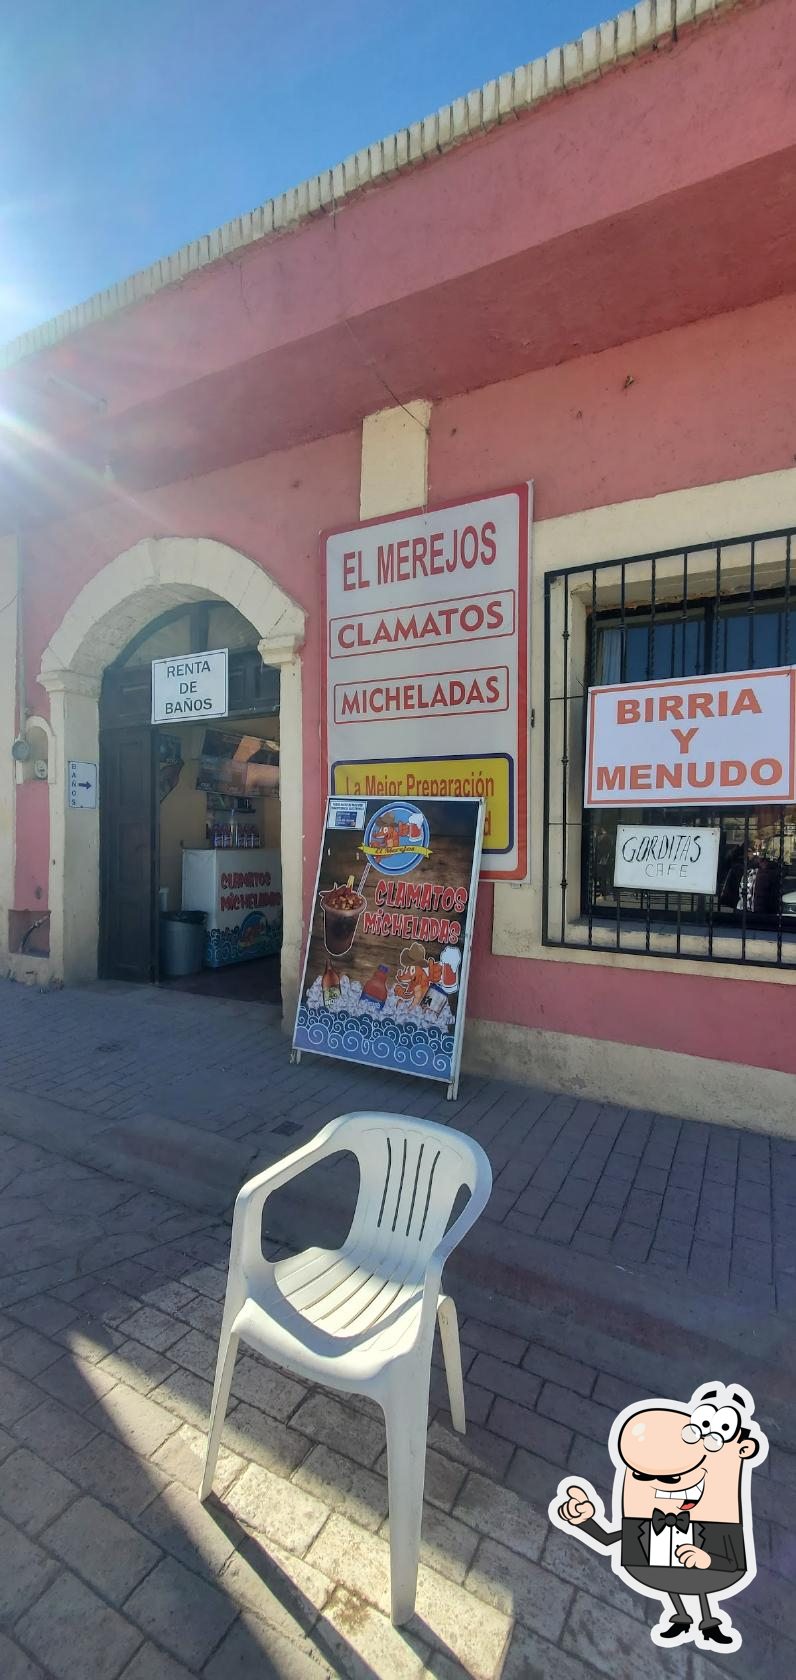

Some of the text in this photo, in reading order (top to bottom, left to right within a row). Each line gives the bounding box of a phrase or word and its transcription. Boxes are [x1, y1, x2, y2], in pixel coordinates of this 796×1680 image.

[343, 521, 497, 592] EL MEREJOS
[337, 600, 504, 649] CLAMATOS
[167, 660, 211, 678] RENTA
[179, 681, 198, 694] DE
[341, 675, 500, 715] MICHELADAS
[165, 697, 213, 714] BAÑOS
[616, 688, 762, 725] BIRRIA
[670, 727, 699, 754] Y
[596, 758, 783, 791] MENUDO
[622, 834, 702, 863] GORDITAS
[645, 862, 689, 878] CAFE
[374, 879, 468, 913] CLAMATOS
